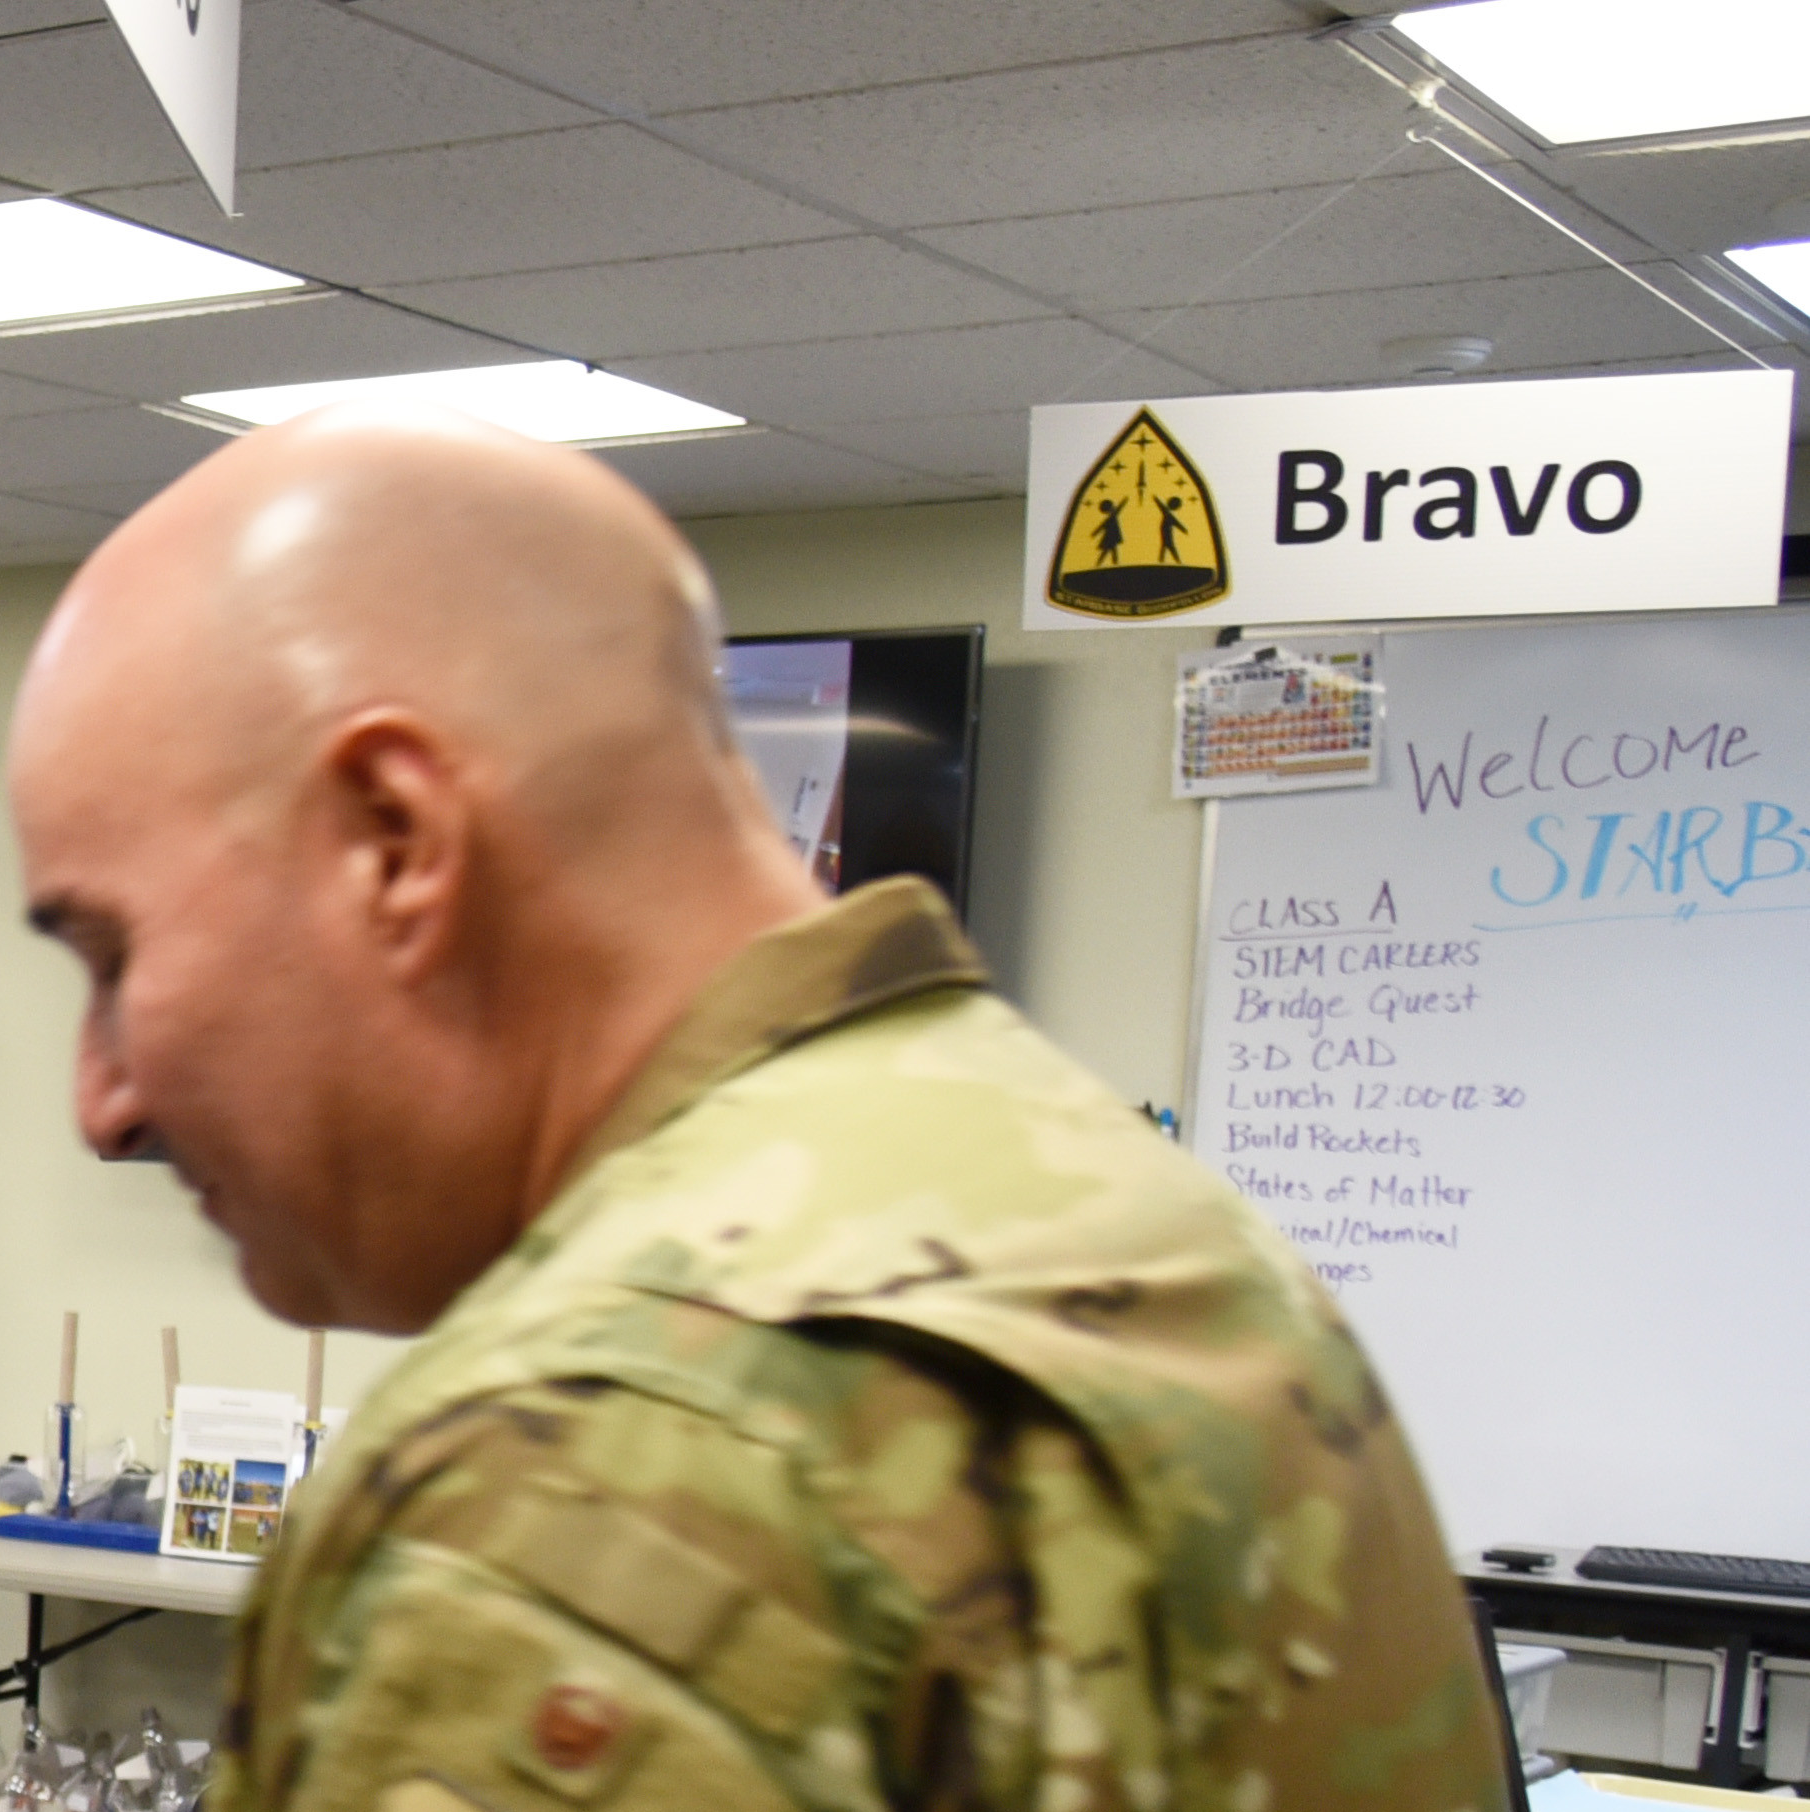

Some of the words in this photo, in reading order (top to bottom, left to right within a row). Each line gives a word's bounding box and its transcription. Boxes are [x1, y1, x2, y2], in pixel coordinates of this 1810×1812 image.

[1275, 448, 1643, 546] Bravo
[1490, 800, 1810, 908] STARB
[1229, 896, 1340, 935] CLASS
[1367, 879, 1397, 924] A
[1233, 943, 1325, 979] STEM
[1338, 940, 1481, 975] CAREERS
[1234, 986, 1351, 1038] Bridge
[1368, 982, 1481, 1024] Quest
[1312, 1037, 1397, 1072] CAD
[1227, 1081, 1334, 1110] Lunch
[1225, 1122, 1298, 1154] Build
[1307, 1122, 1421, 1158] Rockets
[1325, 1175, 1354, 1202] of
[1370, 1174, 1472, 1207] Matter
